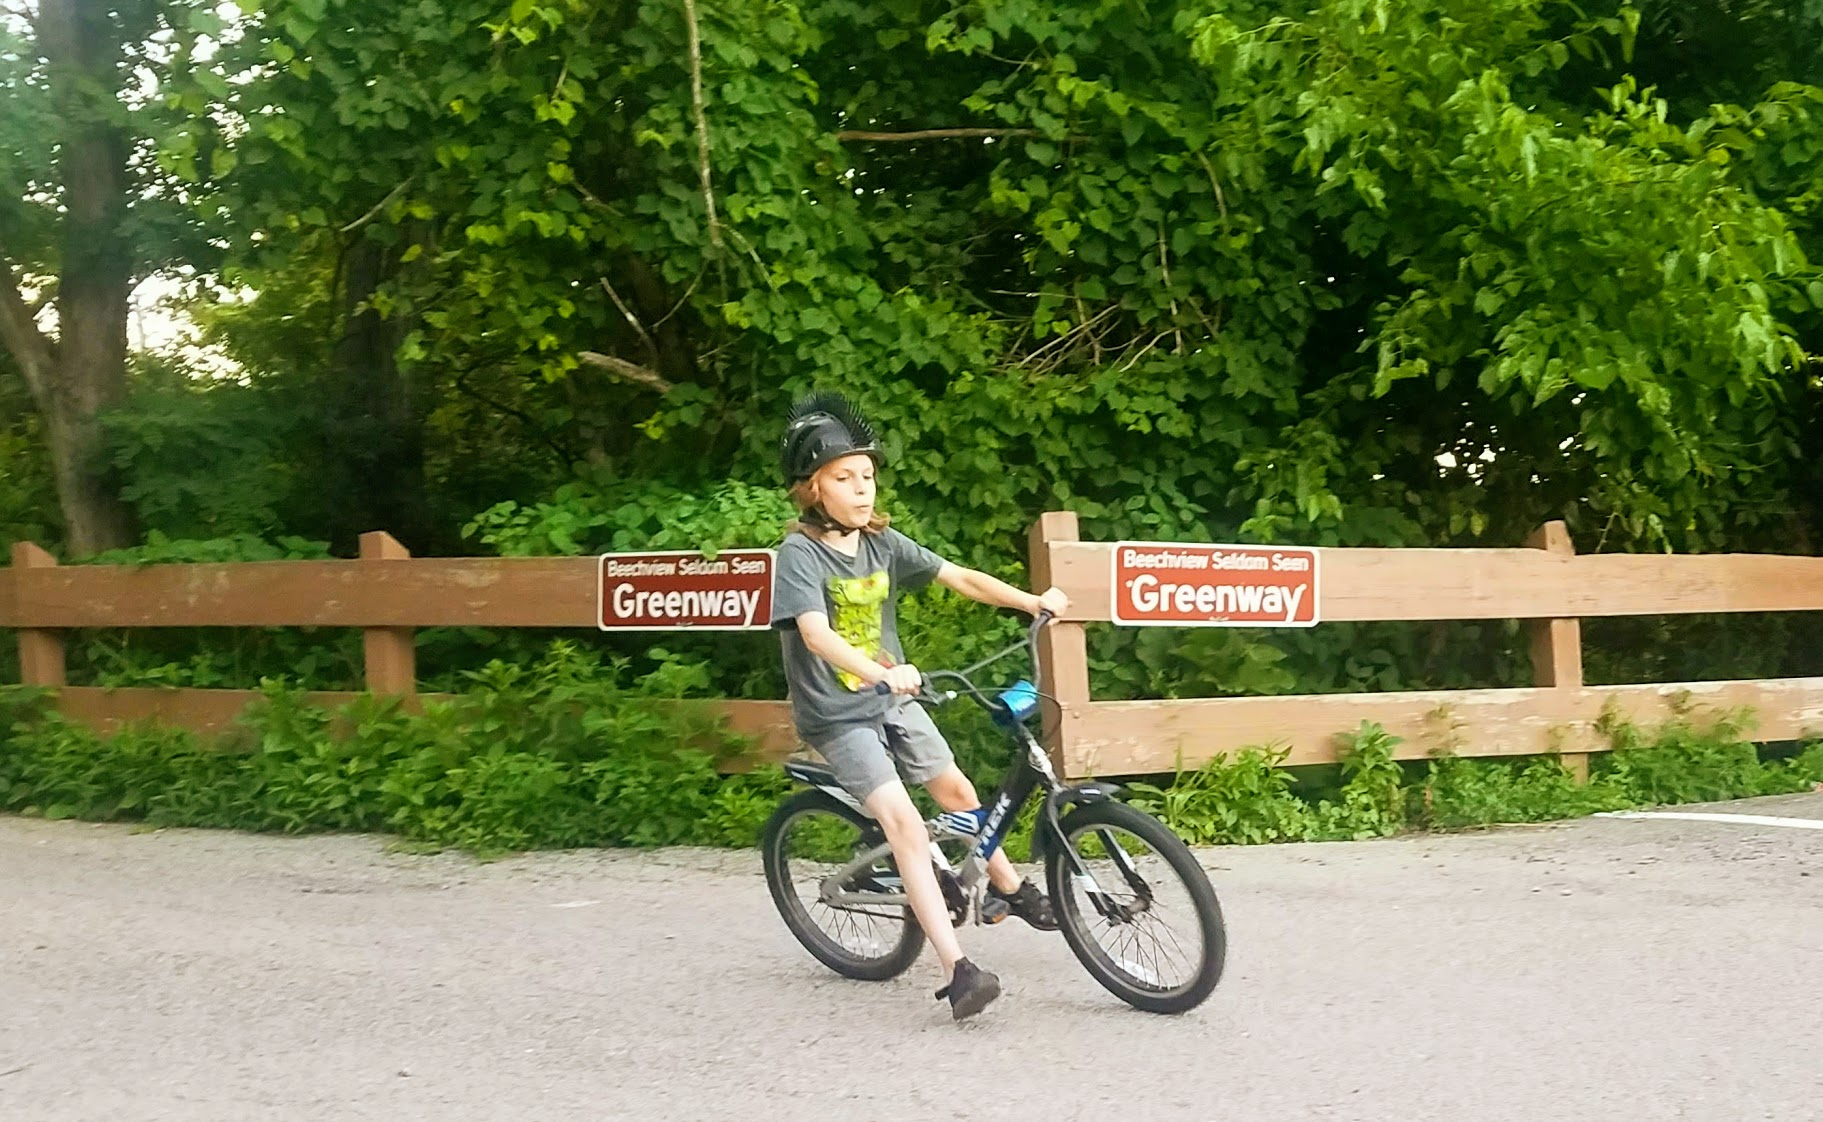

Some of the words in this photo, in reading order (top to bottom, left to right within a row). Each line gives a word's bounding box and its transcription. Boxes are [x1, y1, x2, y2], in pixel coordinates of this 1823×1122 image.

[607, 558, 677, 577] Beechview
[678, 557, 729, 576] Seldom
[731, 556, 766, 575] Seen
[1123, 548, 1209, 570] Beechview
[1211, 551, 1269, 571] Seldom
[1271, 552, 1309, 572] Seen
[612, 582, 764, 628] Greenway
[1126, 574, 1307, 624] Greenway
[973, 792, 1011, 859] TREK
